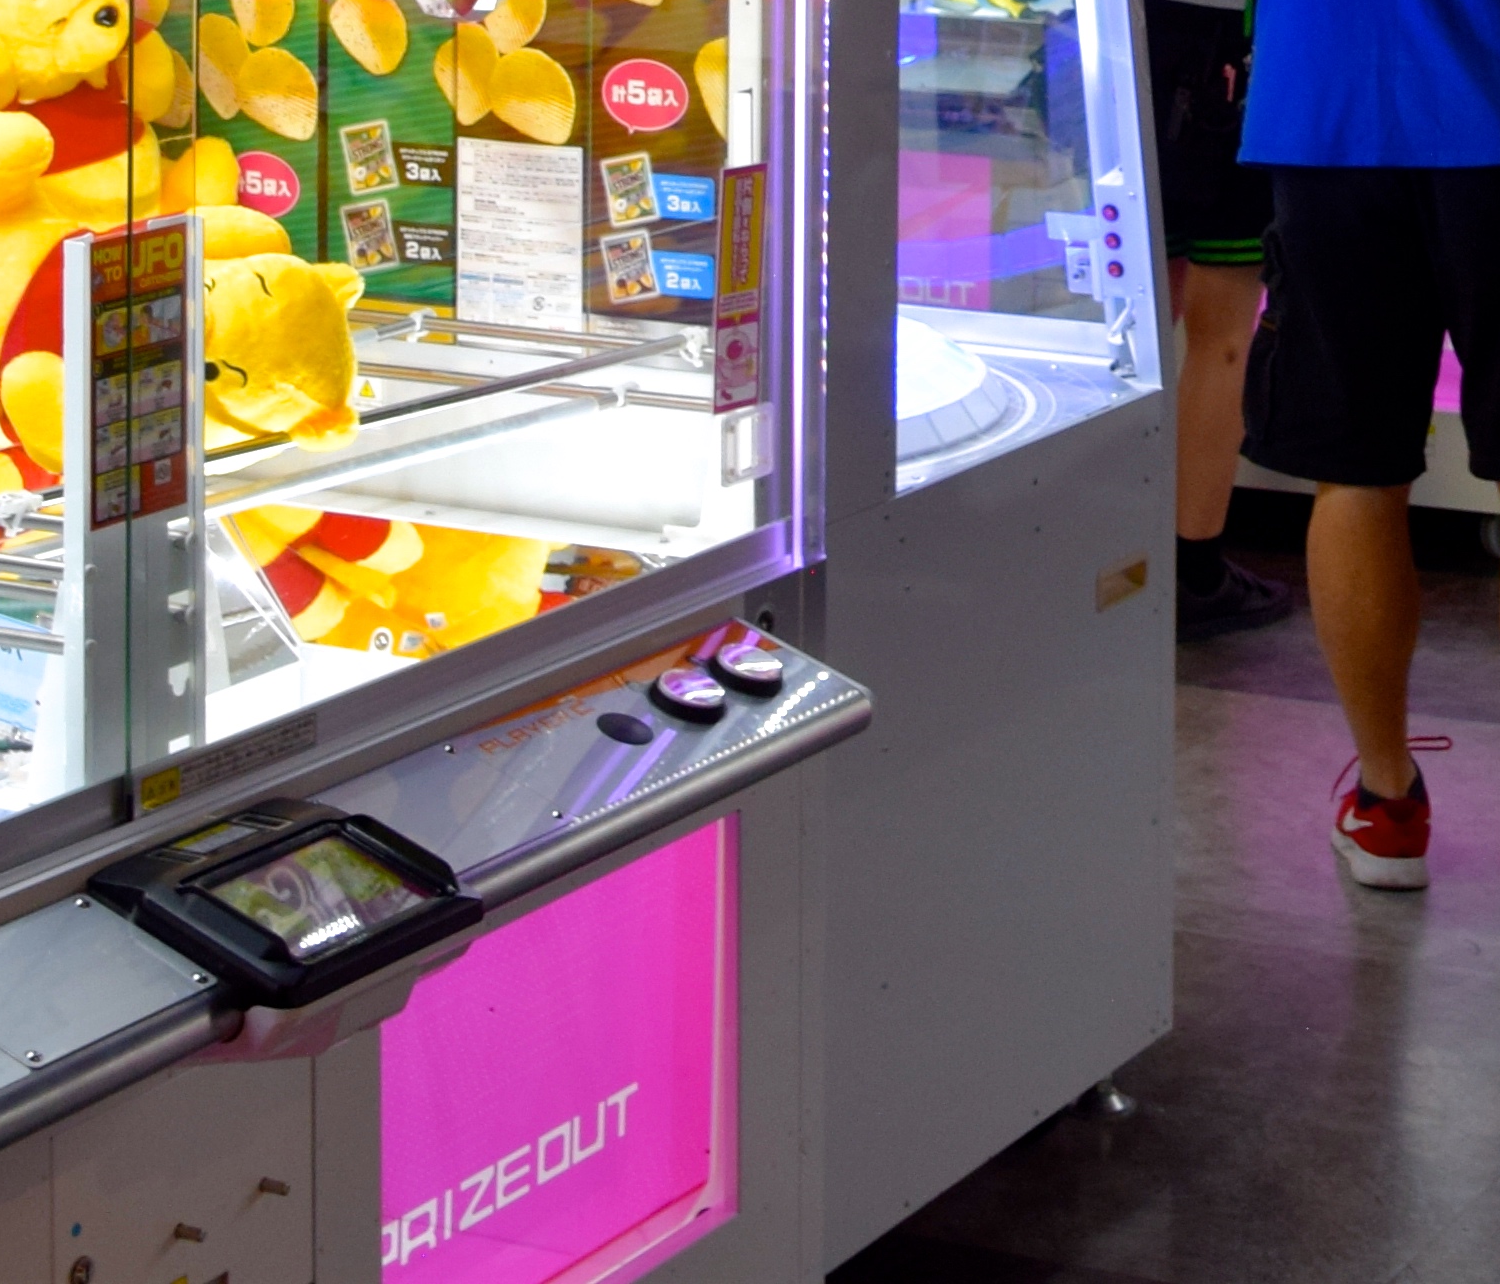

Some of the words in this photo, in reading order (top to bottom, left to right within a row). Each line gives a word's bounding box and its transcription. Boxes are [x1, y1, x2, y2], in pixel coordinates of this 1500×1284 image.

[611, 79, 679, 108] 計5袋入
[404, 162, 442, 183] 3袋入
[93, 243, 123, 266] HOW
[125, 231, 185, 279] UFO
[404, 241, 443, 261] 2袋入
[104, 265, 123, 282] TO
[536, 1081, 640, 1187] OUT
